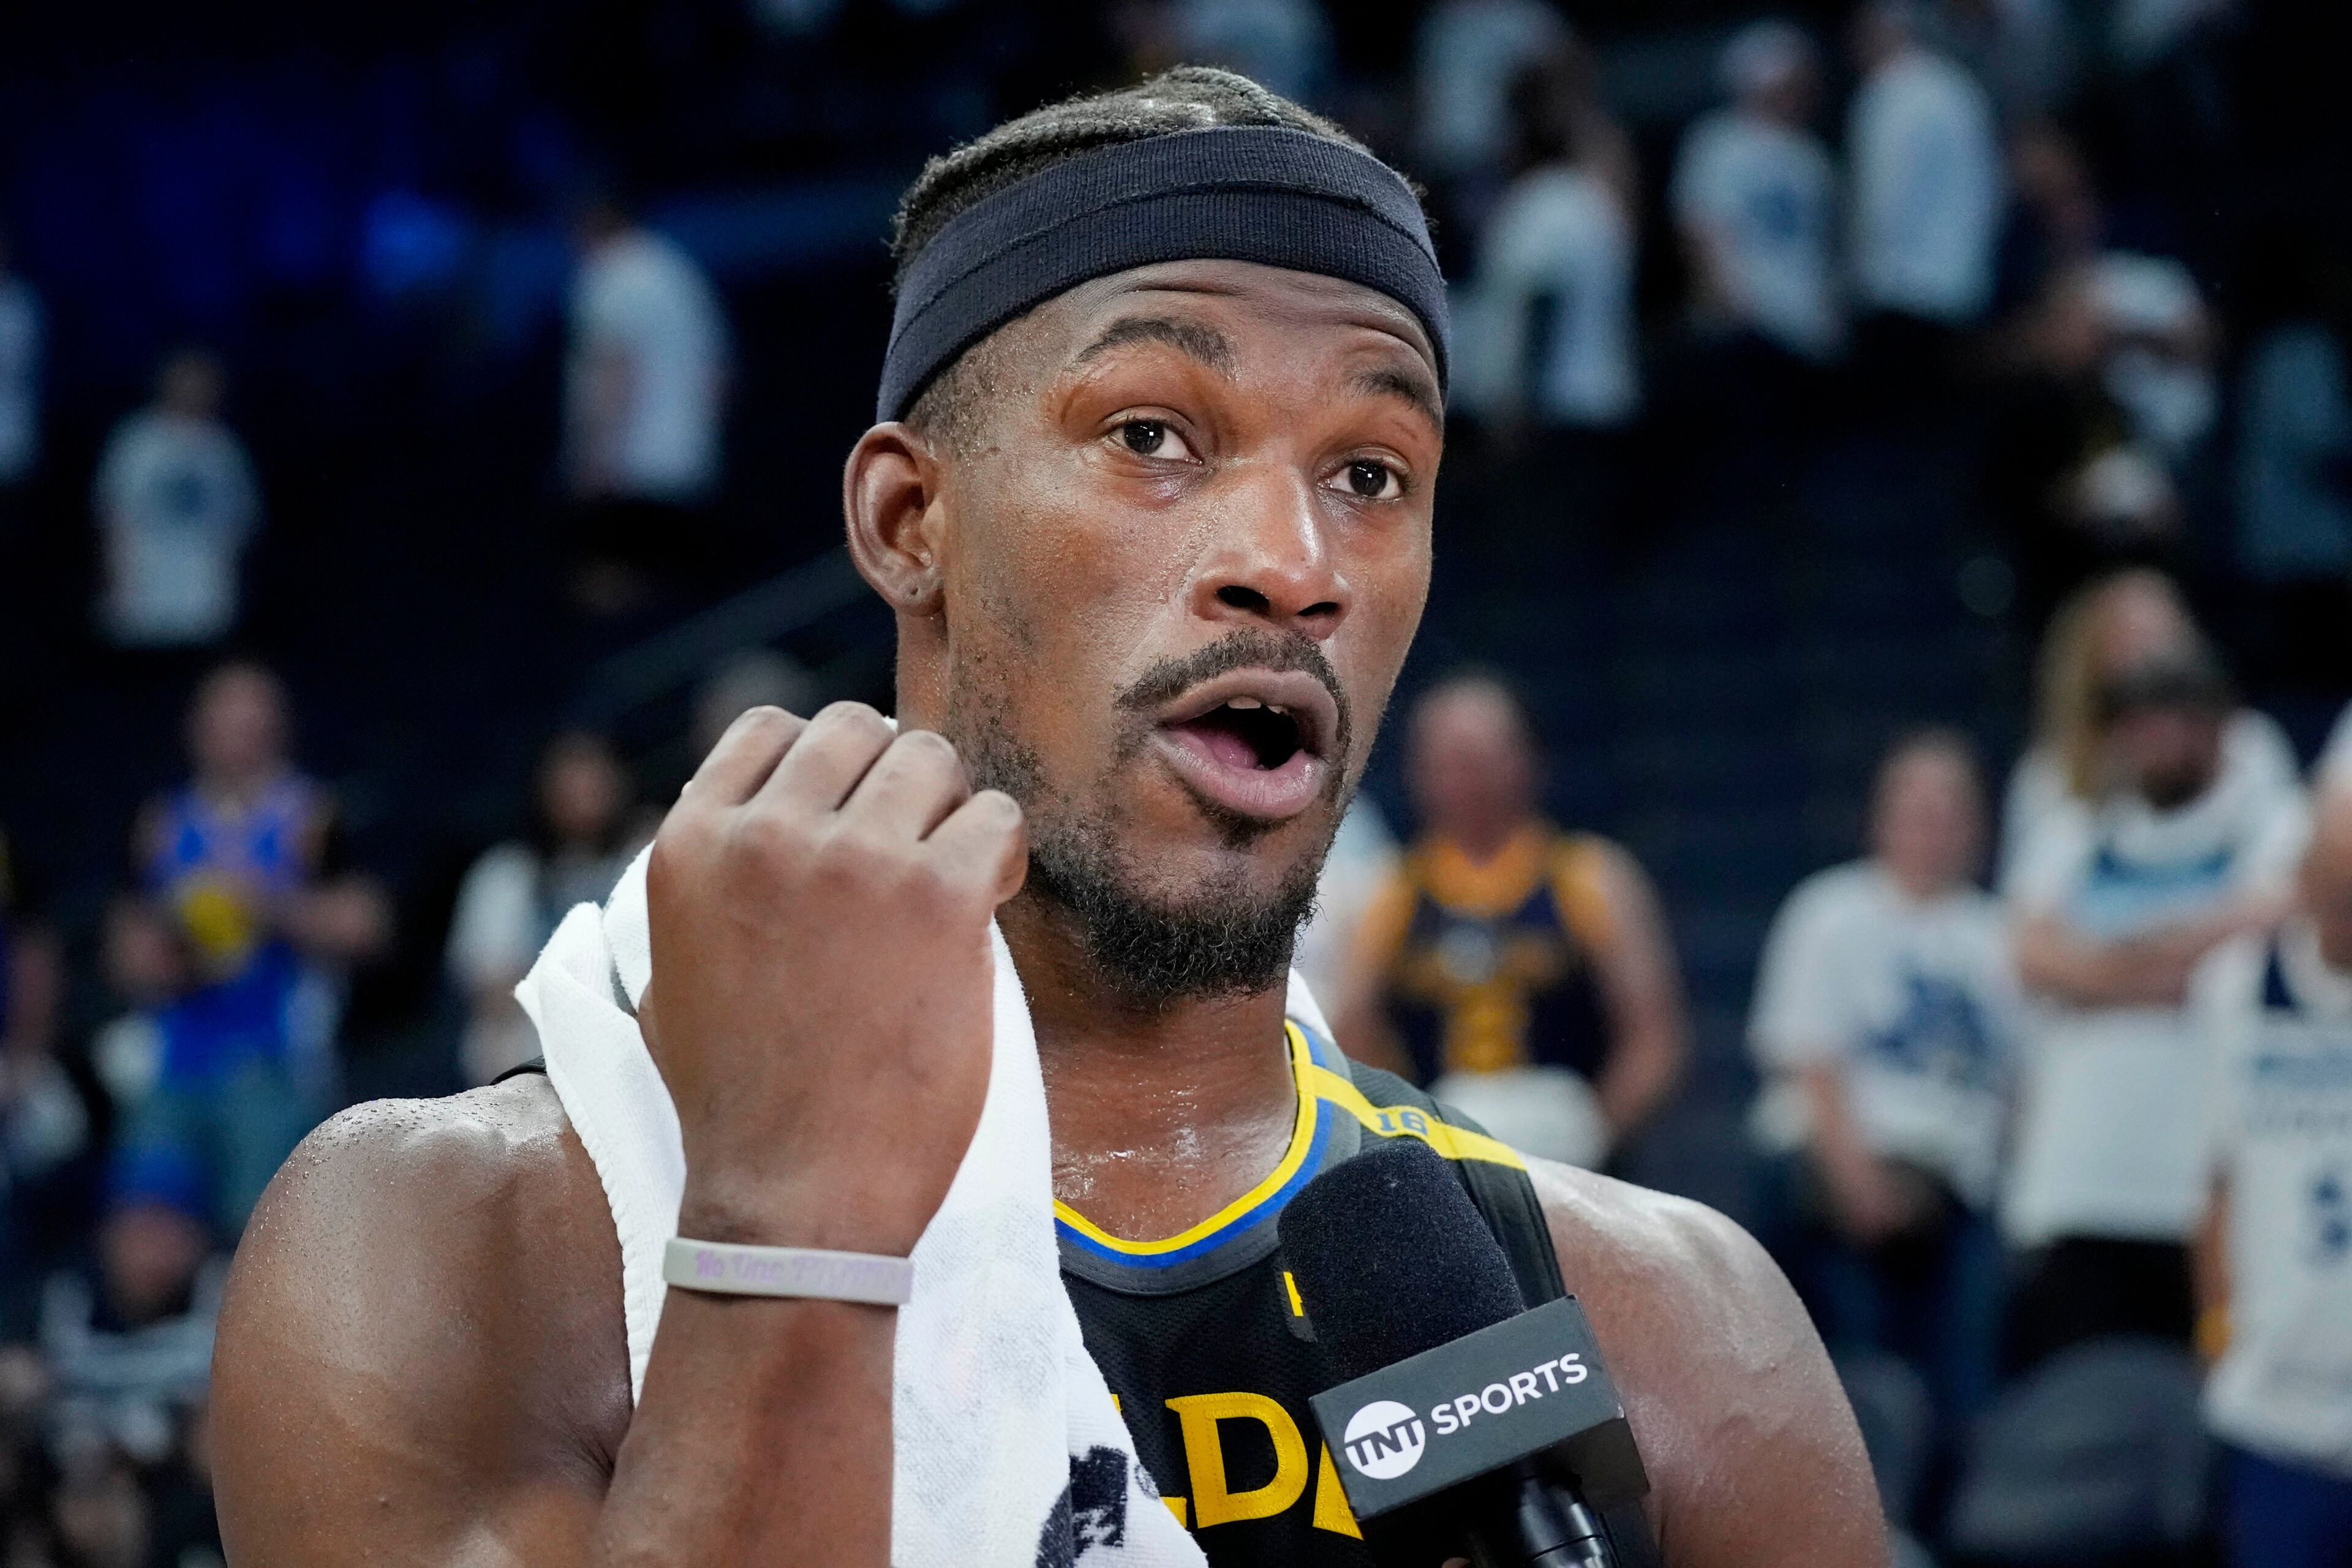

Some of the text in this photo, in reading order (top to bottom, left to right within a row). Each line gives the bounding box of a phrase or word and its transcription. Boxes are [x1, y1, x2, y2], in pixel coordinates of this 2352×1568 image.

[1377, 1111, 1428, 1136] 16
[1344, 1353, 1588, 1466] TNT SPORTS
